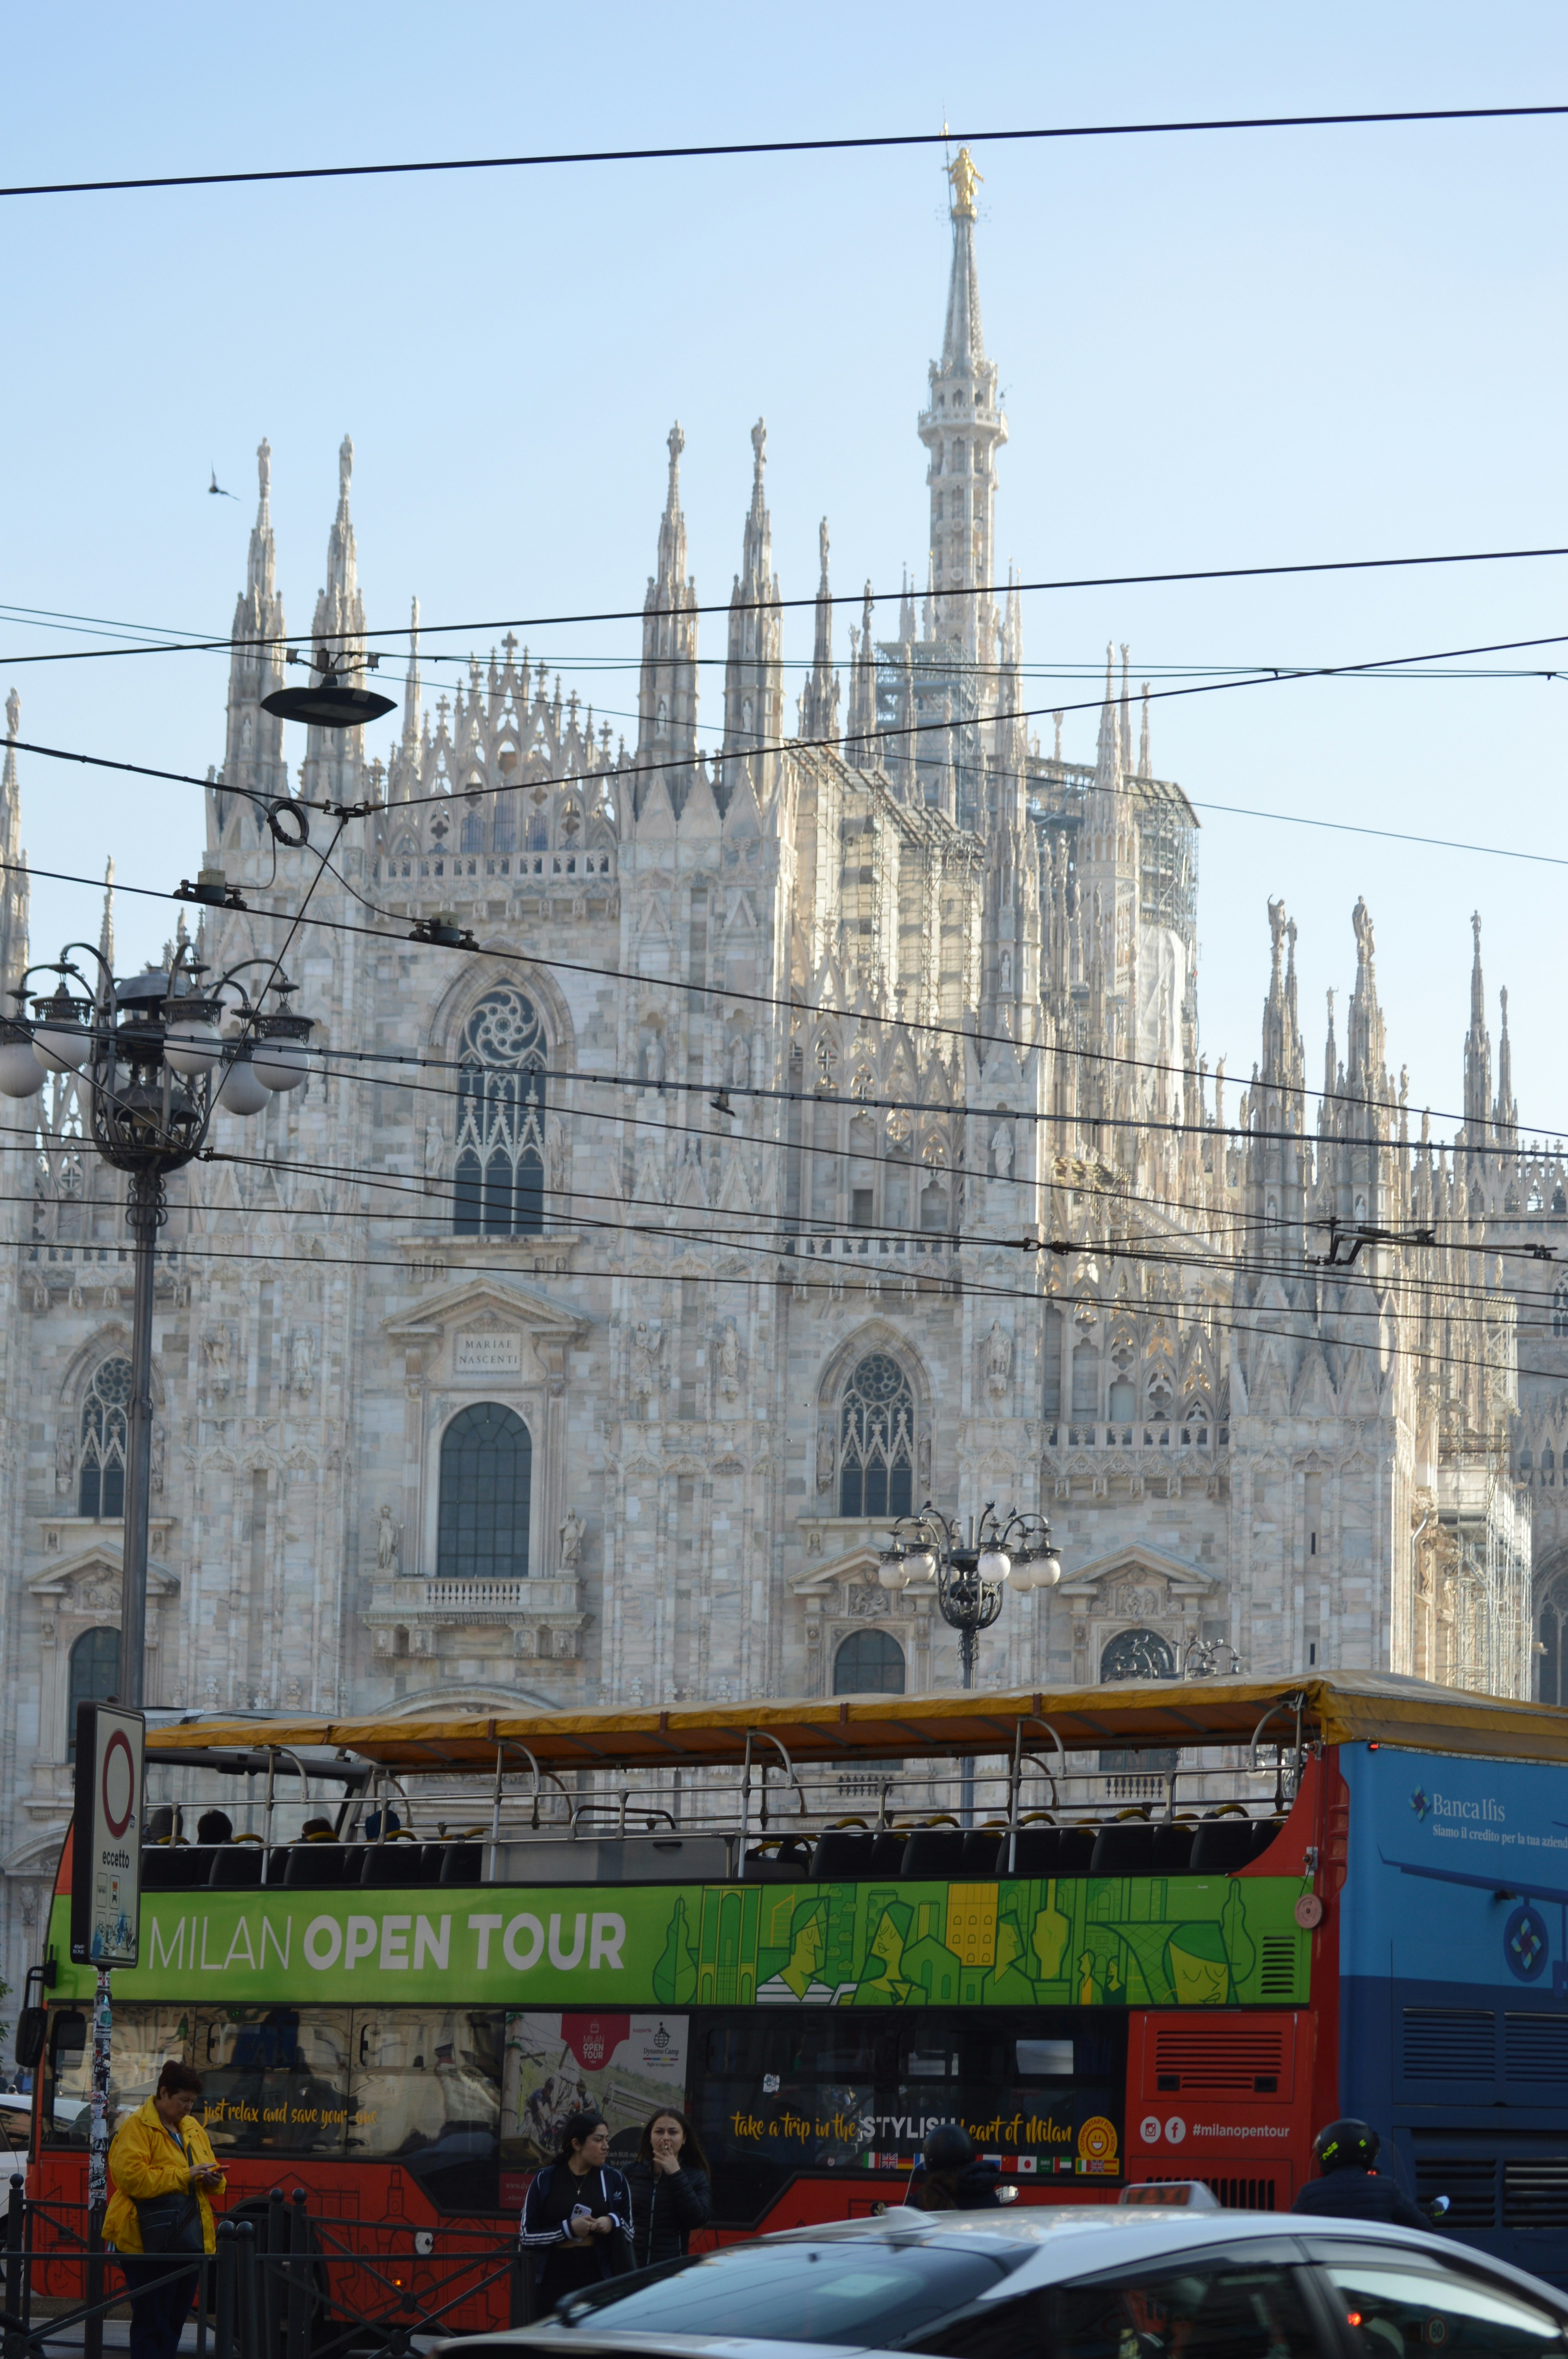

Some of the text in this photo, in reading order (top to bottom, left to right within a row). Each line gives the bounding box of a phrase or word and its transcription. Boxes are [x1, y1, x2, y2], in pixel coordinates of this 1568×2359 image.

[465, 1340, 512, 1348] MARIAE
[459, 1355, 517, 1364] NASCENTI
[1433, 1793, 1479, 1819] Banca
[1433, 1824, 1568, 1849] Siamo il credito per la tua aziend
[102, 1849, 129, 1869] eccetto
[149, 1912, 626, 1970] MILAN OPEN TOUR
[583, 2035, 604, 2043] MILAN
[583, 2043, 604, 2051] OPEN
[643, 2048, 679, 2056] Dynamo Camp
[202, 2097, 230, 2128] just
[228, 2099, 259, 2123] relax
[263, 2101, 288, 2124] and
[291, 2108, 318, 2123] save
[321, 2109, 348, 2129] your
[730, 2110, 765, 2140] take
[769, 2121, 781, 2137] a
[779, 2112, 810, 2145] trip
[815, 2117, 830, 2137] in
[830, 2112, 858, 2142] the
[1005, 2112, 1024, 2145] of
[1026, 2115, 1072, 2143] Milan
[1104, 2121, 1114, 2135] FOR
[1192, 2123, 1289, 2139] #milanopentour
[1432, 2323, 1442, 2338] 80
